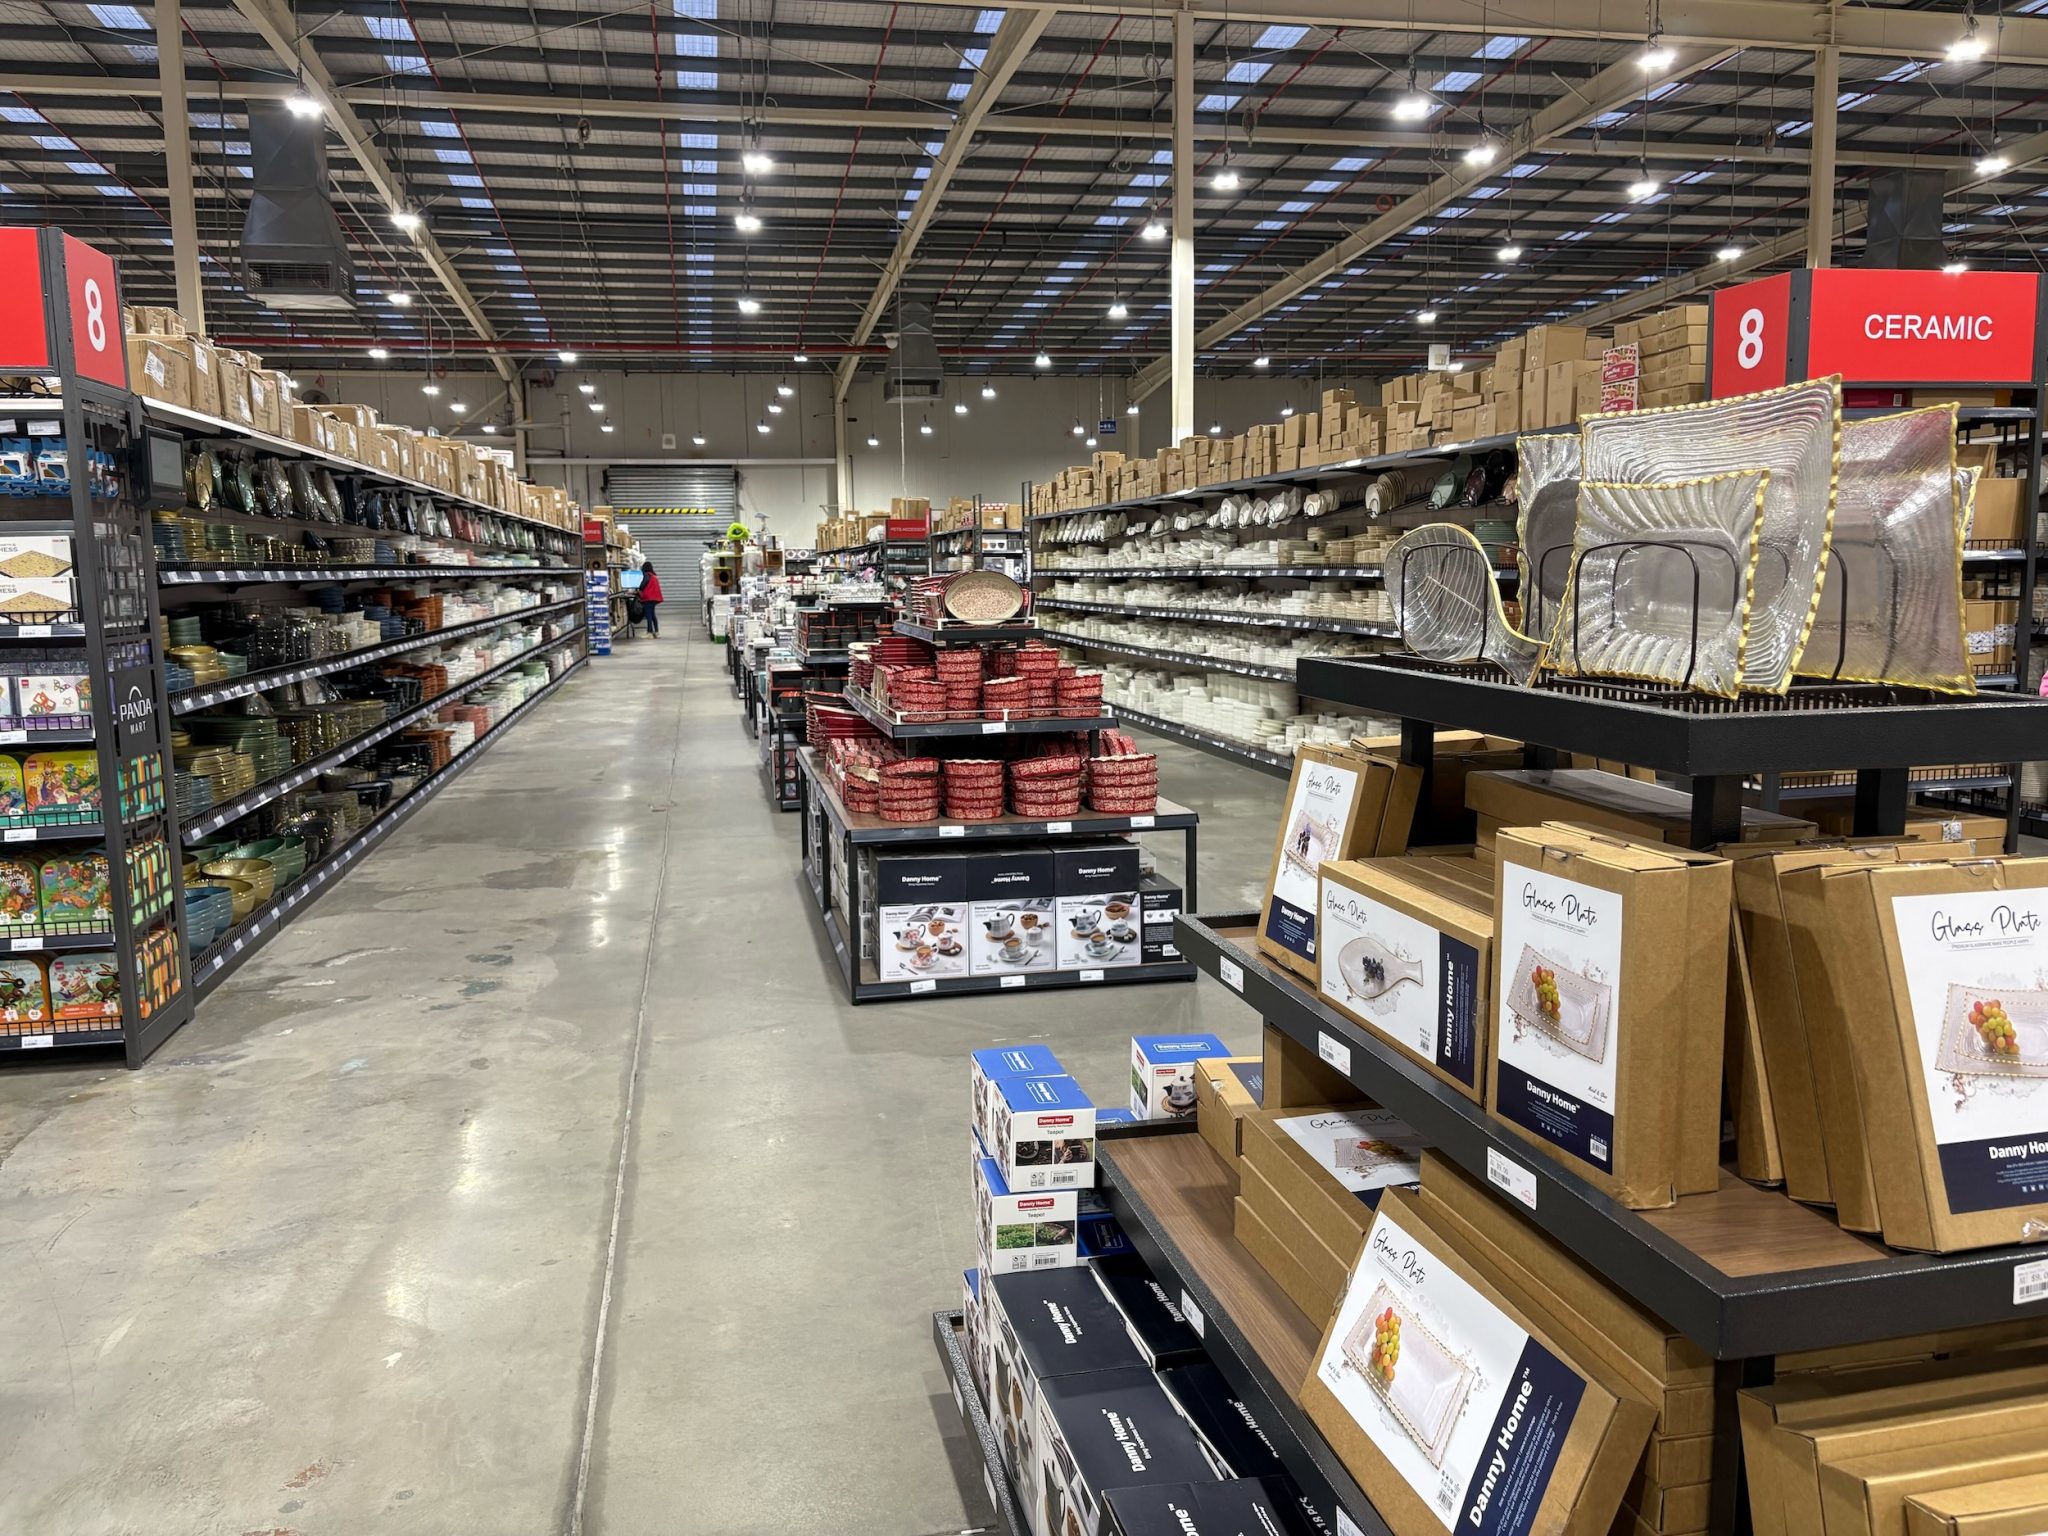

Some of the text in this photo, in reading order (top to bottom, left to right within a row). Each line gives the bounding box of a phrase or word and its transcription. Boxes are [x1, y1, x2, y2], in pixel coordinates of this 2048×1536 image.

[84, 278, 106, 352] 8
[1864, 314, 1993, 341] CERAMIC
[1737, 307, 1764, 370] 8
[120, 698, 152, 722] PANDA
[130, 720, 146, 735] MART
[901, 876, 921, 884] Danny
[1281, 905, 1294, 920] Danny
[1326, 889, 1346, 913] Glass
[1348, 900, 1367, 924] Plate
[1523, 882, 1556, 914] Glass
[1561, 894, 1597, 926] Plate
[1932, 905, 2041, 941] Glass Plate
[1444, 1008, 1454, 1058] Danny
[1526, 1080, 1552, 1103] Danny
[1310, 1119, 1356, 1129] Glass
[1989, 1145, 2028, 1159] Danny
[1373, 1227, 1397, 1262] Glass
[1402, 1250, 1426, 1284] Plate
[1163, 1302, 1185, 1322] Danny
[1057, 1322, 1077, 1344] Danny
[1121, 1441, 1147, 1472] Danny
[1469, 1449, 1506, 1528] Danny
